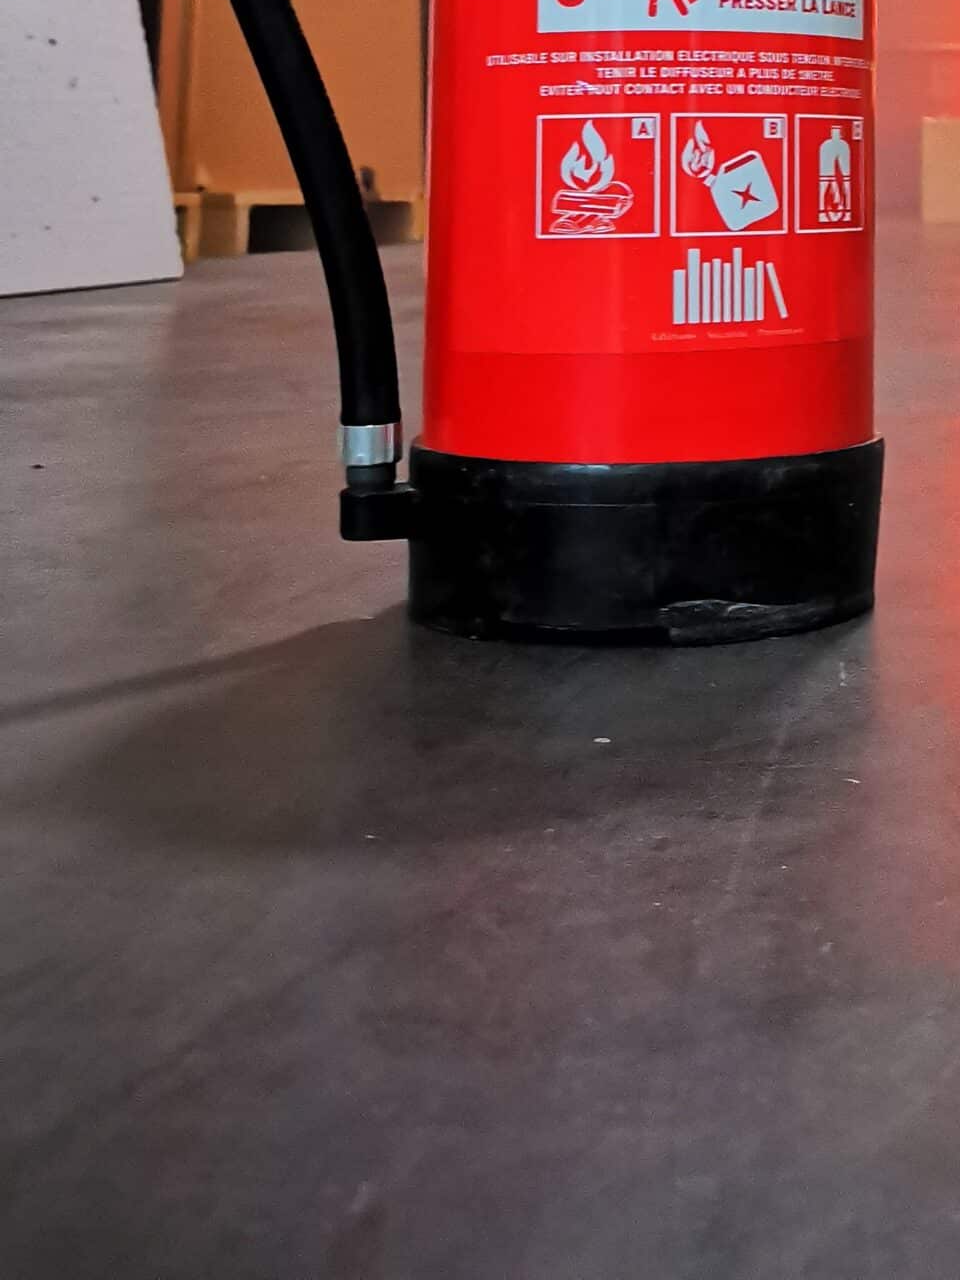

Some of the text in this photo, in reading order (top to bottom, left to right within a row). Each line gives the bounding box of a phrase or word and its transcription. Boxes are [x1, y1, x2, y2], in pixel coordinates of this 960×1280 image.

[822, 0, 856, 18] LANCE
[551, 51, 577, 63] SUR
[640, 67, 656, 78] LE
[736, 68, 746, 78] A
[750, 68, 779, 79] PLUS
[782, 69, 796, 80] DE
[624, 83, 686, 95] CONTACT
[688, 83, 723, 95] AVEC
[726, 84, 744, 95] UN
[637, 121, 649, 136] A
[769, 121, 779, 136] B
